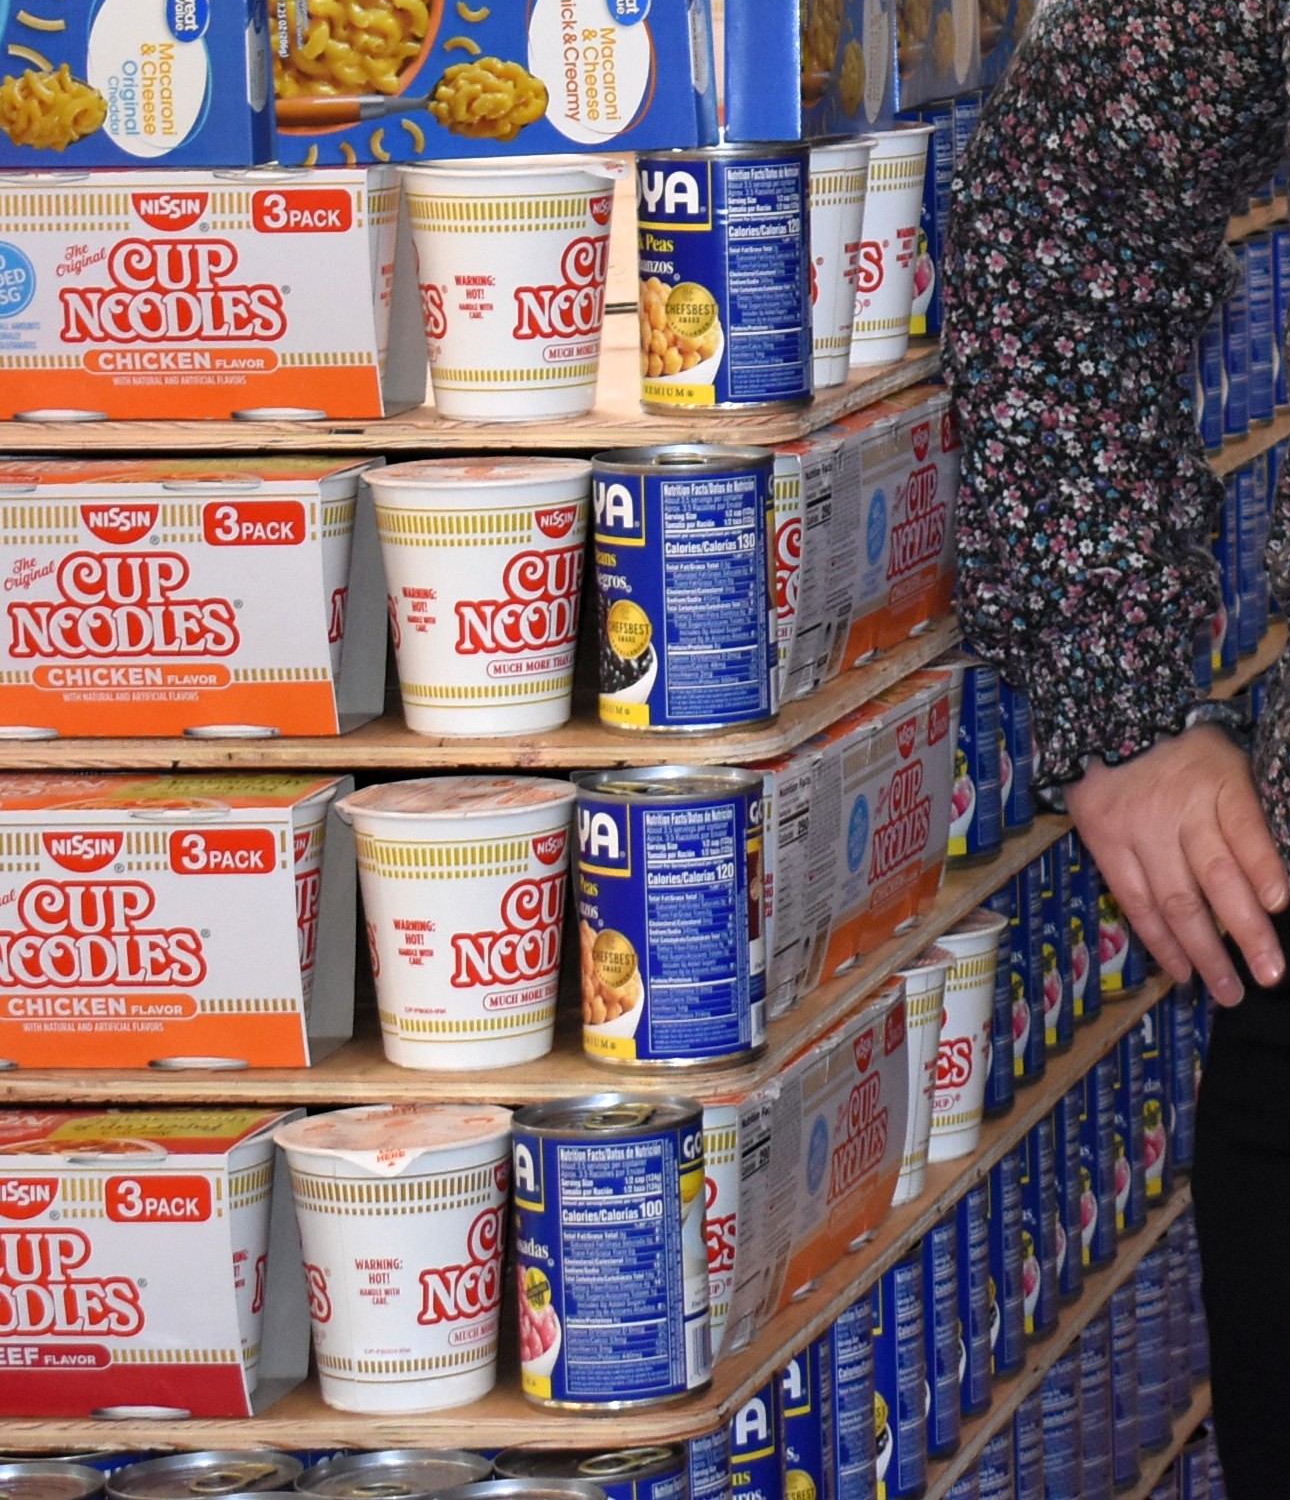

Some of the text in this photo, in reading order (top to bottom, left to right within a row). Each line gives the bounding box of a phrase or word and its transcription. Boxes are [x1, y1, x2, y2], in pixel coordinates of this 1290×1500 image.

[563, 35, 577, 45] &
[564, 47, 580, 121] Creamy
[582, 28, 599, 120] & Cheese
[600, 27, 621, 120] Macaroni
[119, 61, 139, 135] Original
[141, 44, 157, 135] & Cheese
[159, 43, 177, 136] Macaroni
[108, 76, 119, 135] Cheddar
[637, 169, 699, 214] YA
[140, 195, 201, 220] NISSIN
[65, 245, 88, 260] The
[646, 234, 674, 252] Peas
[56, 247, 107, 277] Original
[110, 239, 237, 290] CUP
[561, 236, 611, 286] CU
[466, 289, 484, 299] HOT!
[61, 285, 286, 341] NOODLES
[666, 303, 715, 315] CHEFSBEST
[98, 352, 264, 370] CHICKEN FLAVOR
[549, 347, 574, 358] MUCH
[90, 508, 150, 531] NISSIN
[541, 510, 574, 527] NISSIN
[665, 533, 755, 554] Calories/Calorías 130
[4, 560, 55, 591] Original
[13, 556, 38, 574] The
[58, 552, 189, 603] CUP
[412, 602, 427, 612] HOT!
[9, 599, 239, 657] NOODLES
[47, 668, 217, 686] CHICKEN FLAVOR
[493, 663, 523, 675] MUCH
[526, 661, 550, 673] MORE
[890, 758, 923, 822] CUP
[51, 835, 115, 859] NISSIN
[648, 863, 734, 885] Calories/Calorías 120
[18, 880, 155, 933] CUP
[501, 873, 568, 930] CU
[393, 919, 436, 931] WARNING:
[405, 934, 424, 945] HOT!
[451, 924, 562, 988] NOOD
[8, 997, 183, 1016] CHICKEN FLAVOR
[489, 993, 544, 1007] MUCH MORE
[23, 1022, 41, 1033] WITH
[42, 1022, 76, 1032] NATURAL
[133, 1021, 164, 1031] FLAVORS
[561, 1149, 585, 1161] Nutrition
[0, 1181, 50, 1206] ISSIN
[563, 1200, 663, 1222] Calories/Calorías 100
[0, 1228, 90, 1281] UP
[355, 1258, 403, 1270] WARNING:
[368, 1273, 390, 1284] HOT!
[454, 1329, 479, 1343] MUCH
[45, 1355, 96, 1365] FLAVOR
